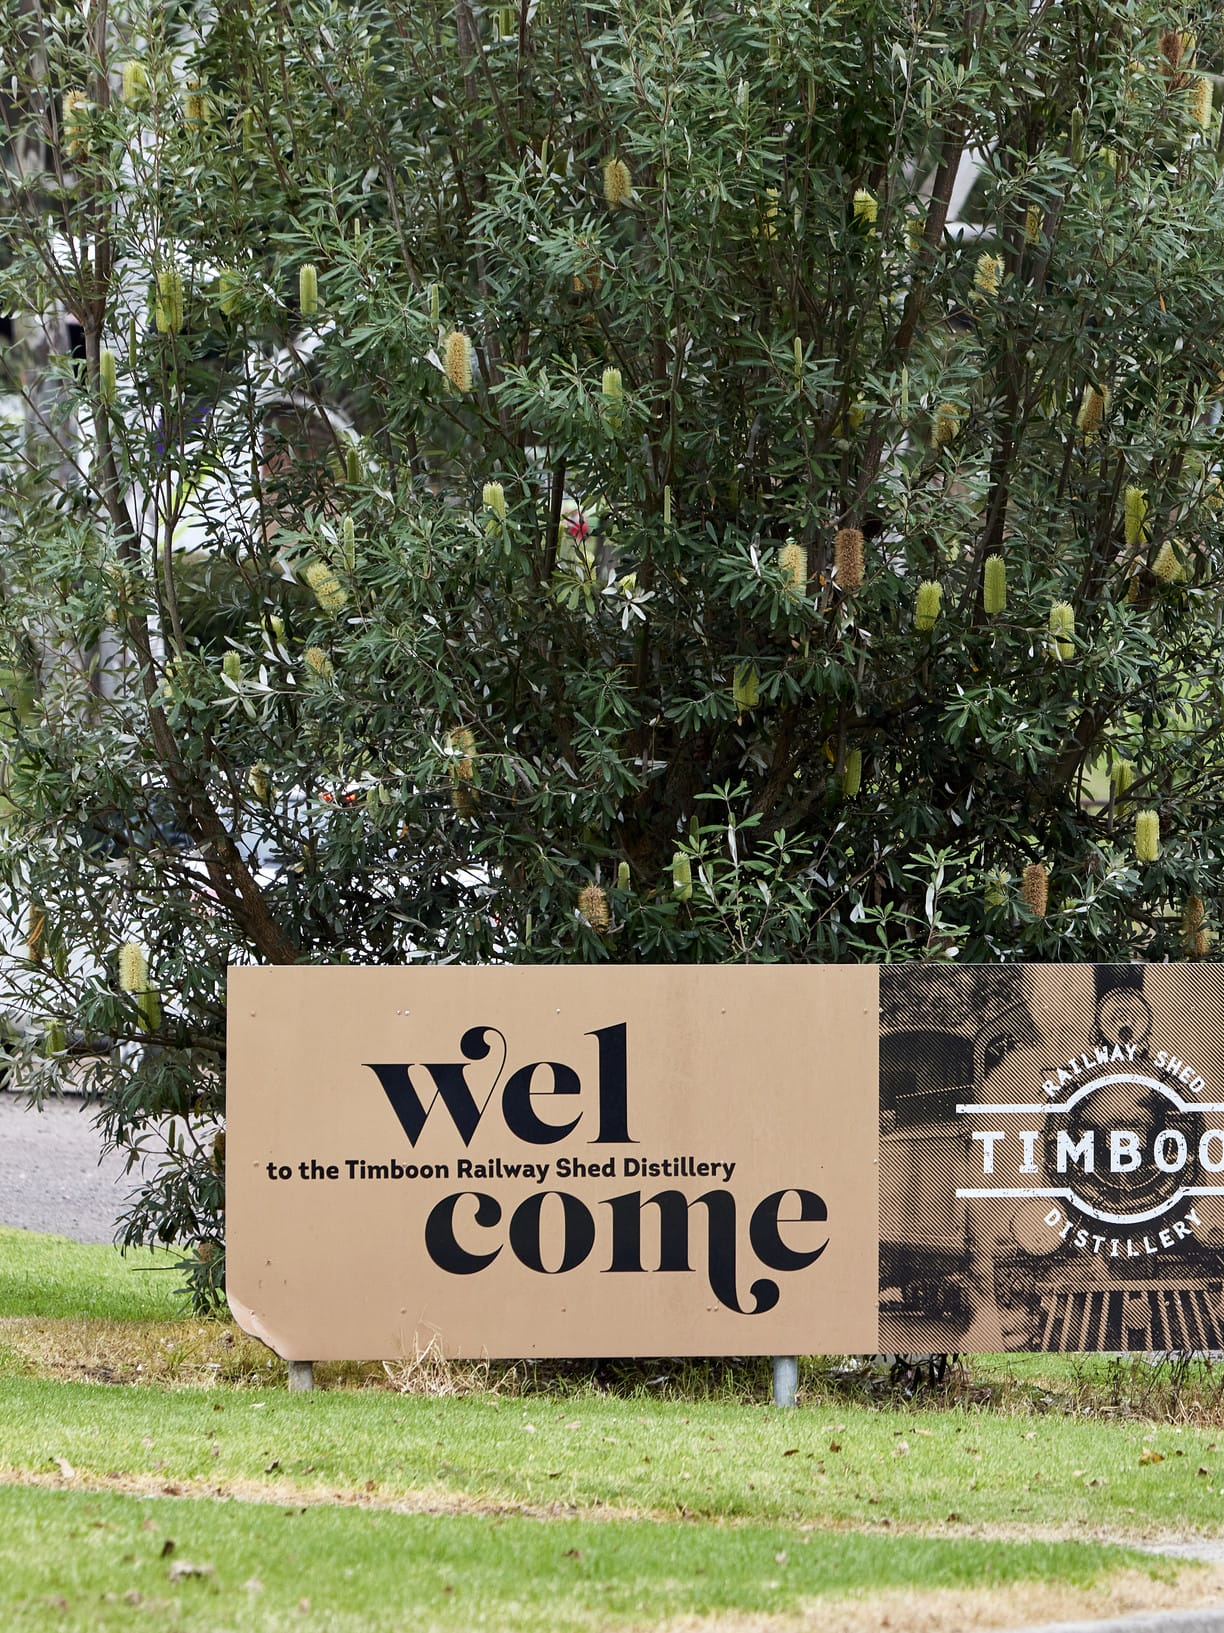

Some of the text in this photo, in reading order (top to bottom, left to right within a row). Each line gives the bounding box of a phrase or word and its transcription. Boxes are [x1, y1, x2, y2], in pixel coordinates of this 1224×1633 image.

[361, 1021, 641, 1148] wel
[1041, 1044, 1206, 1097] RAILWAY SHED
[266, 1157, 736, 1184] to the Timboon Railway Shed Distillery
[424, 1188, 830, 1315] come
[1043, 1208, 1202, 1257] DISTILLERY
